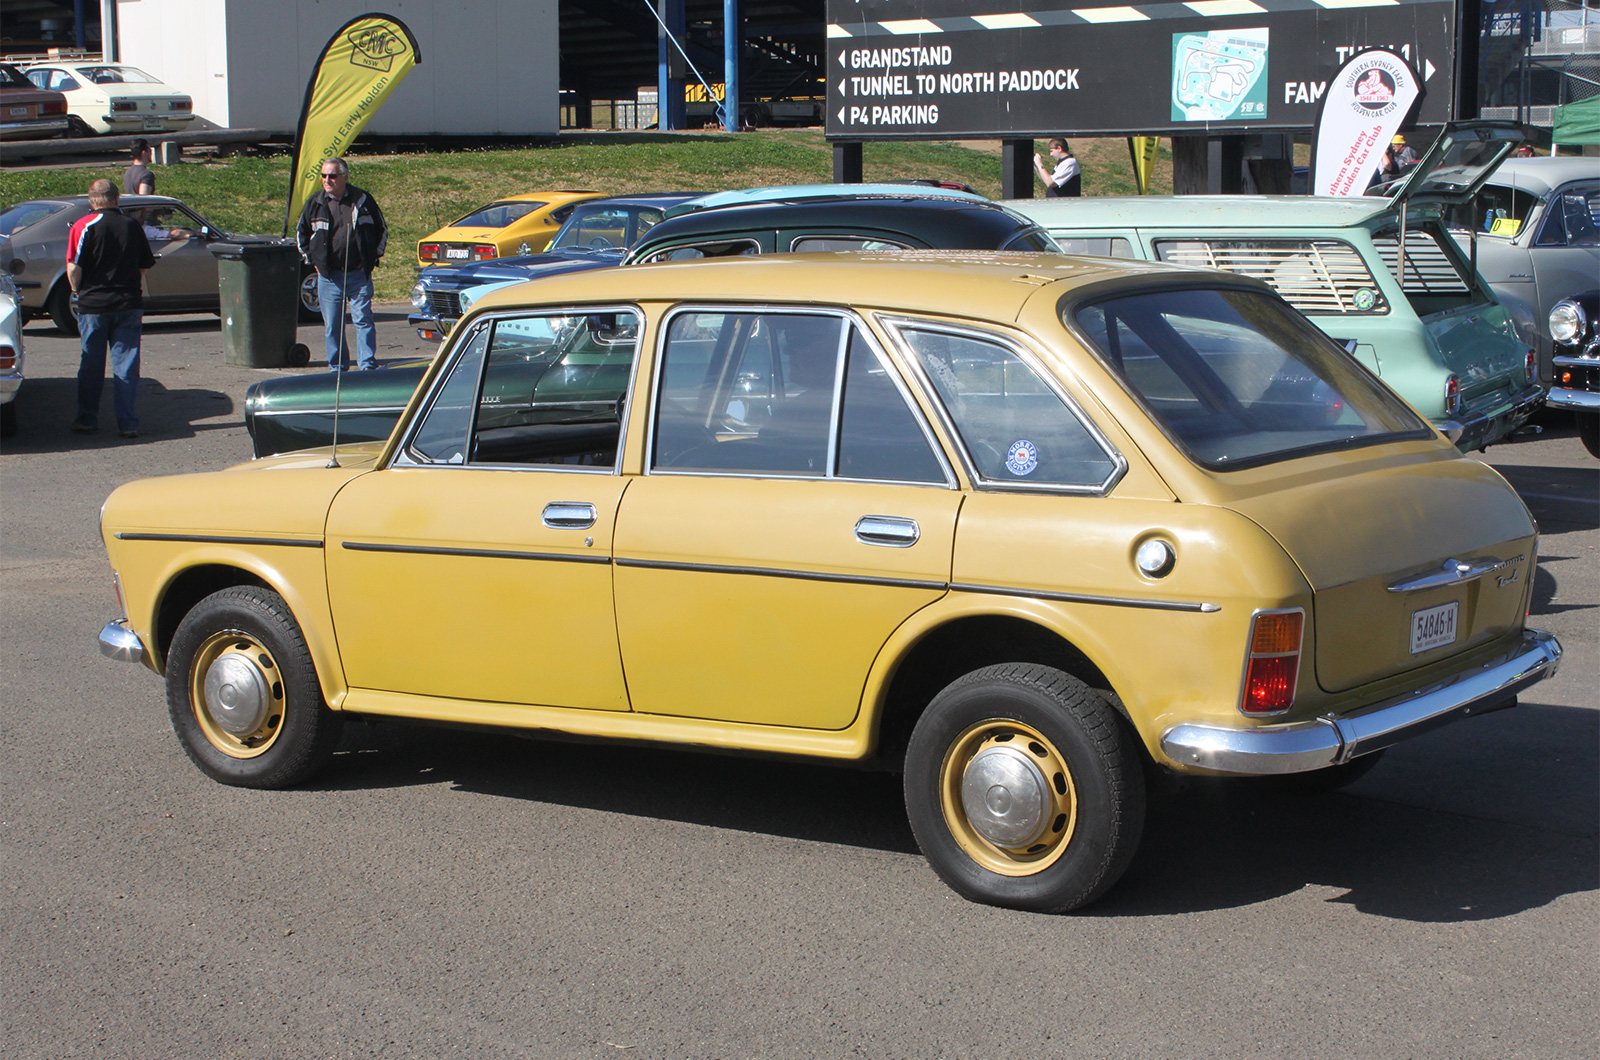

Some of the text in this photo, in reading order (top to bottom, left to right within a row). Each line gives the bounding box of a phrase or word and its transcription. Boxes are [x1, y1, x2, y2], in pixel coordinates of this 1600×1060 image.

[359, 30, 396, 54] CMC
[362, 58, 379, 67] NSW
[851, 45, 952, 69] GRANDSTAND
[851, 68, 1080, 97] TUNNEL TO NORTH PADDOCK
[1346, 61, 1370, 88] SOUTHERN
[1370, 60, 1395, 71] SYDNEY
[1284, 81, 1327, 104] FAM
[323, 136, 342, 157] Syd
[337, 110, 362, 137] Early
[357, 76, 389, 111] Holden
[850, 104, 939, 125] P4 PARKING
[1371, 109, 1384, 118] CAR
[1343, 130, 1368, 166] Sydney
[1356, 148, 1370, 165] Car
[1366, 125, 1383, 147] Club
